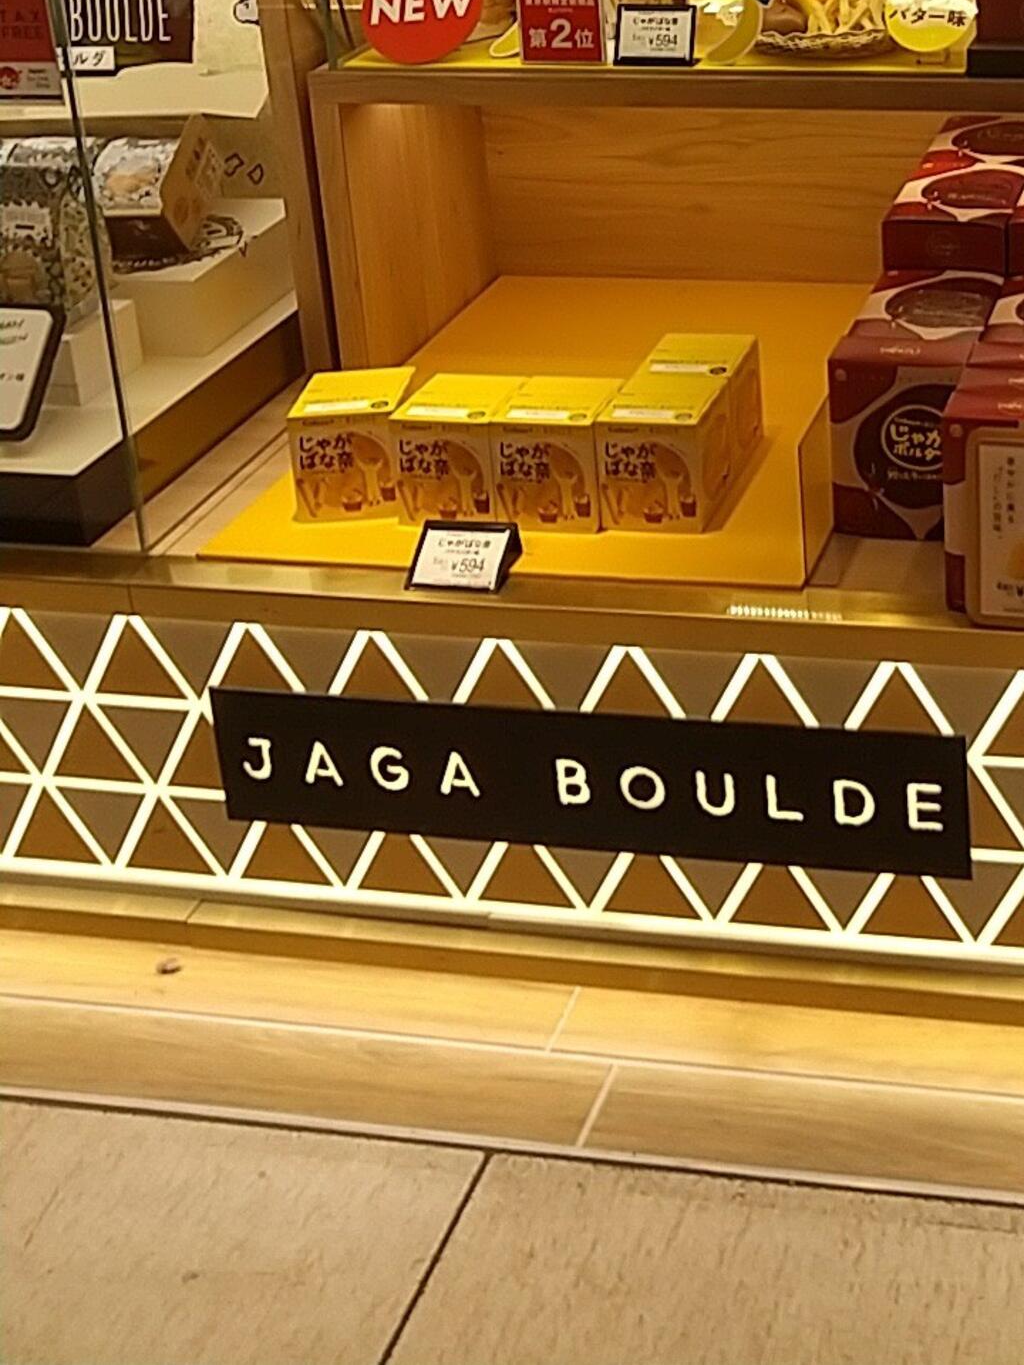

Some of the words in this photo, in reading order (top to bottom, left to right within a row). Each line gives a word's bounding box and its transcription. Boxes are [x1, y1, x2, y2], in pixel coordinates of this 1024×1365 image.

[889, 7, 967, 27] バター味
[529, 18, 595, 49] 第2位
[649, 34, 678, 47] ¥594
[300, 434, 353, 452] じゃが
[400, 439, 449, 456] じゃが
[500, 441, 549, 458] じゃが
[604, 441, 656, 458] じゃが
[451, 557, 486, 573] ¥594
[244, 737, 481, 797] JAGA
[557, 757, 944, 831] BOULDE
